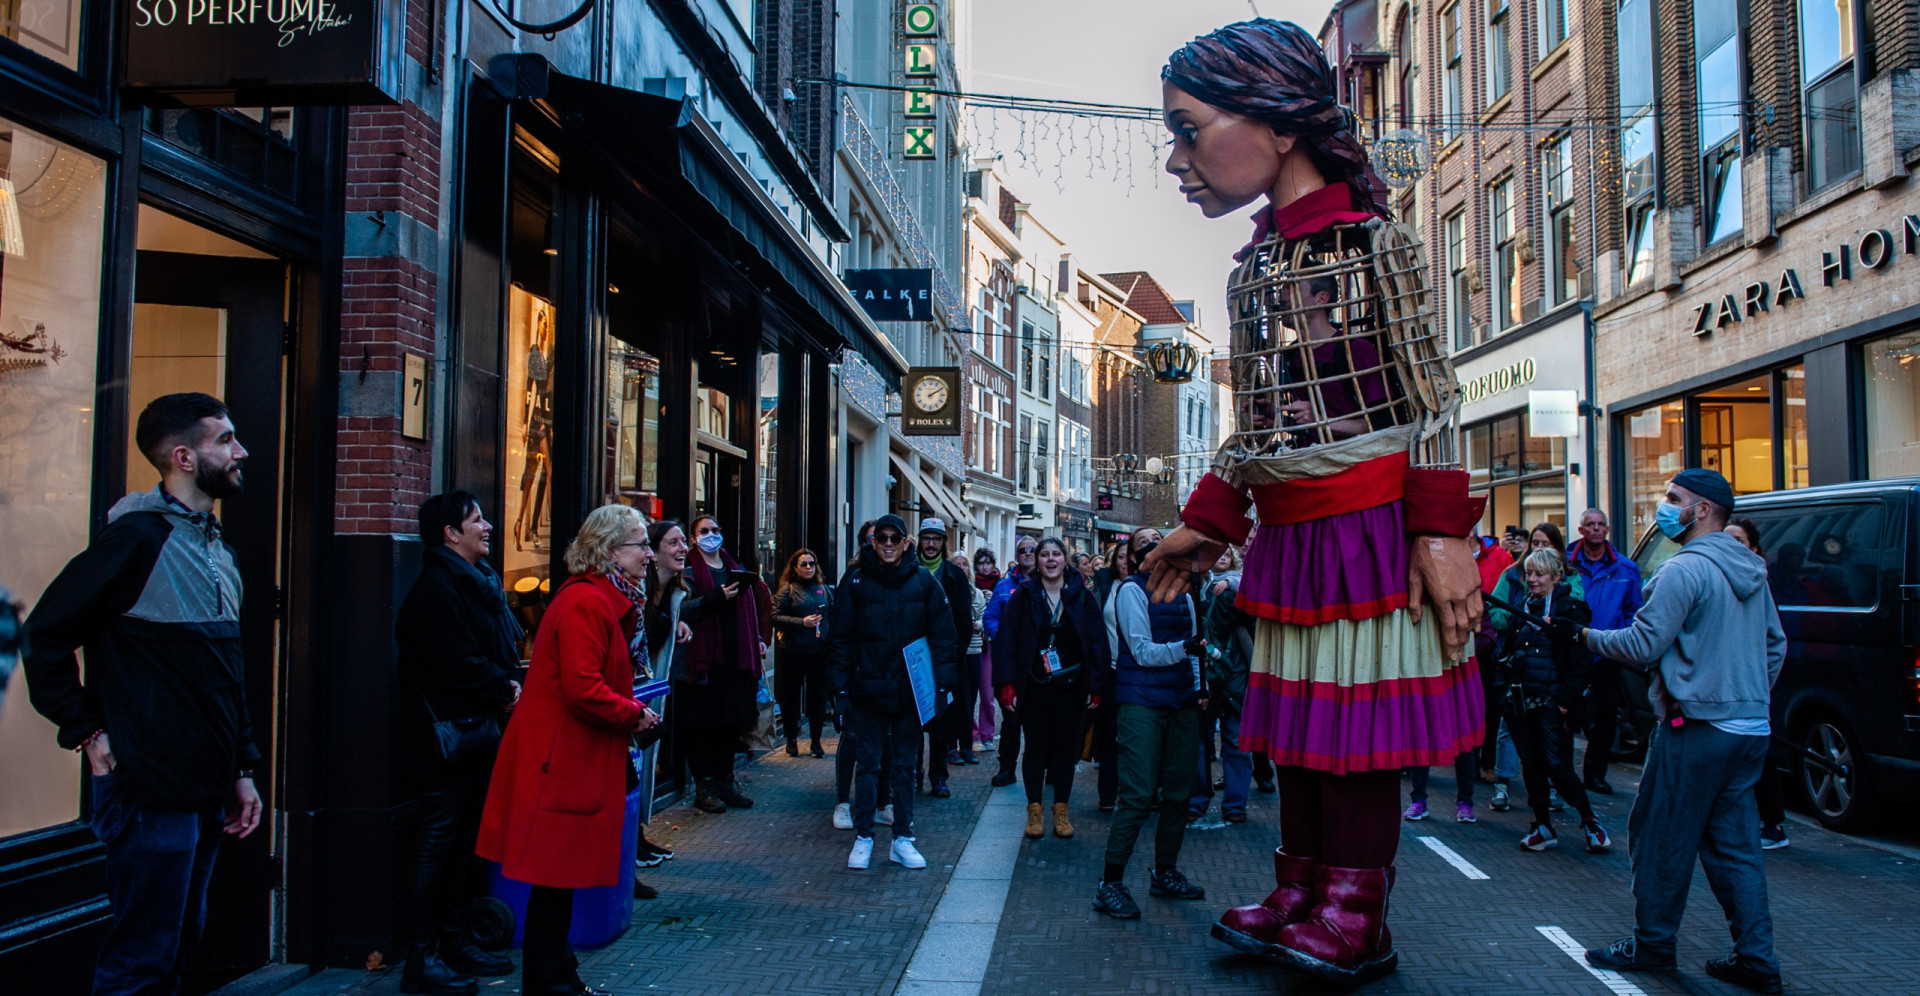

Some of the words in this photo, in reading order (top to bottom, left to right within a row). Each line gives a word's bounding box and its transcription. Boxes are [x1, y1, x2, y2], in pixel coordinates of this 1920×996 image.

[136, 0, 178, 27] SO
[187, 0, 334, 25] PERFUME
[906, 5, 934, 155] OLEX
[1691, 268, 1805, 338] ZARA
[1821, 214, 1920, 287] HOM
[848, 289, 928, 300] FALKE
[412, 377, 423, 407] 7
[1460, 357, 1538, 406] ROFUOMO
[526, 390, 551, 412] FAL
[916, 418, 945, 426] ROLEX
